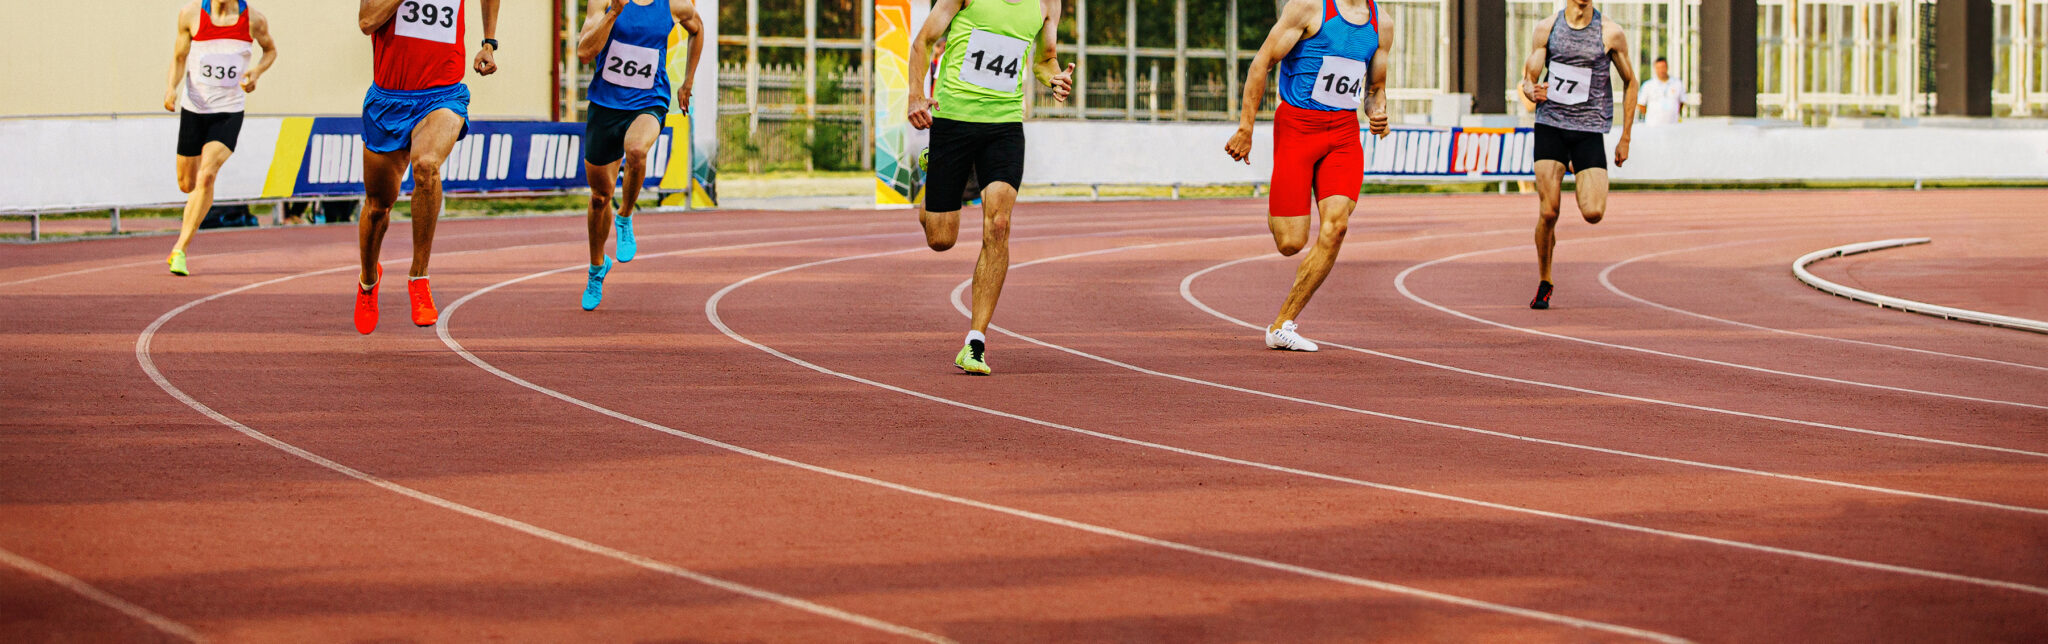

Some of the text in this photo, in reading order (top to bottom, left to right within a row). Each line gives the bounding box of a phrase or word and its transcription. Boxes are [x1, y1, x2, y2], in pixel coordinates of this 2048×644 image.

[402, 0, 454, 28] 393
[202, 64, 237, 79] 336
[607, 55, 652, 80] 264
[970, 50, 1018, 79] 144
[1322, 73, 1360, 98] 164
[1554, 76, 1579, 94] 77
